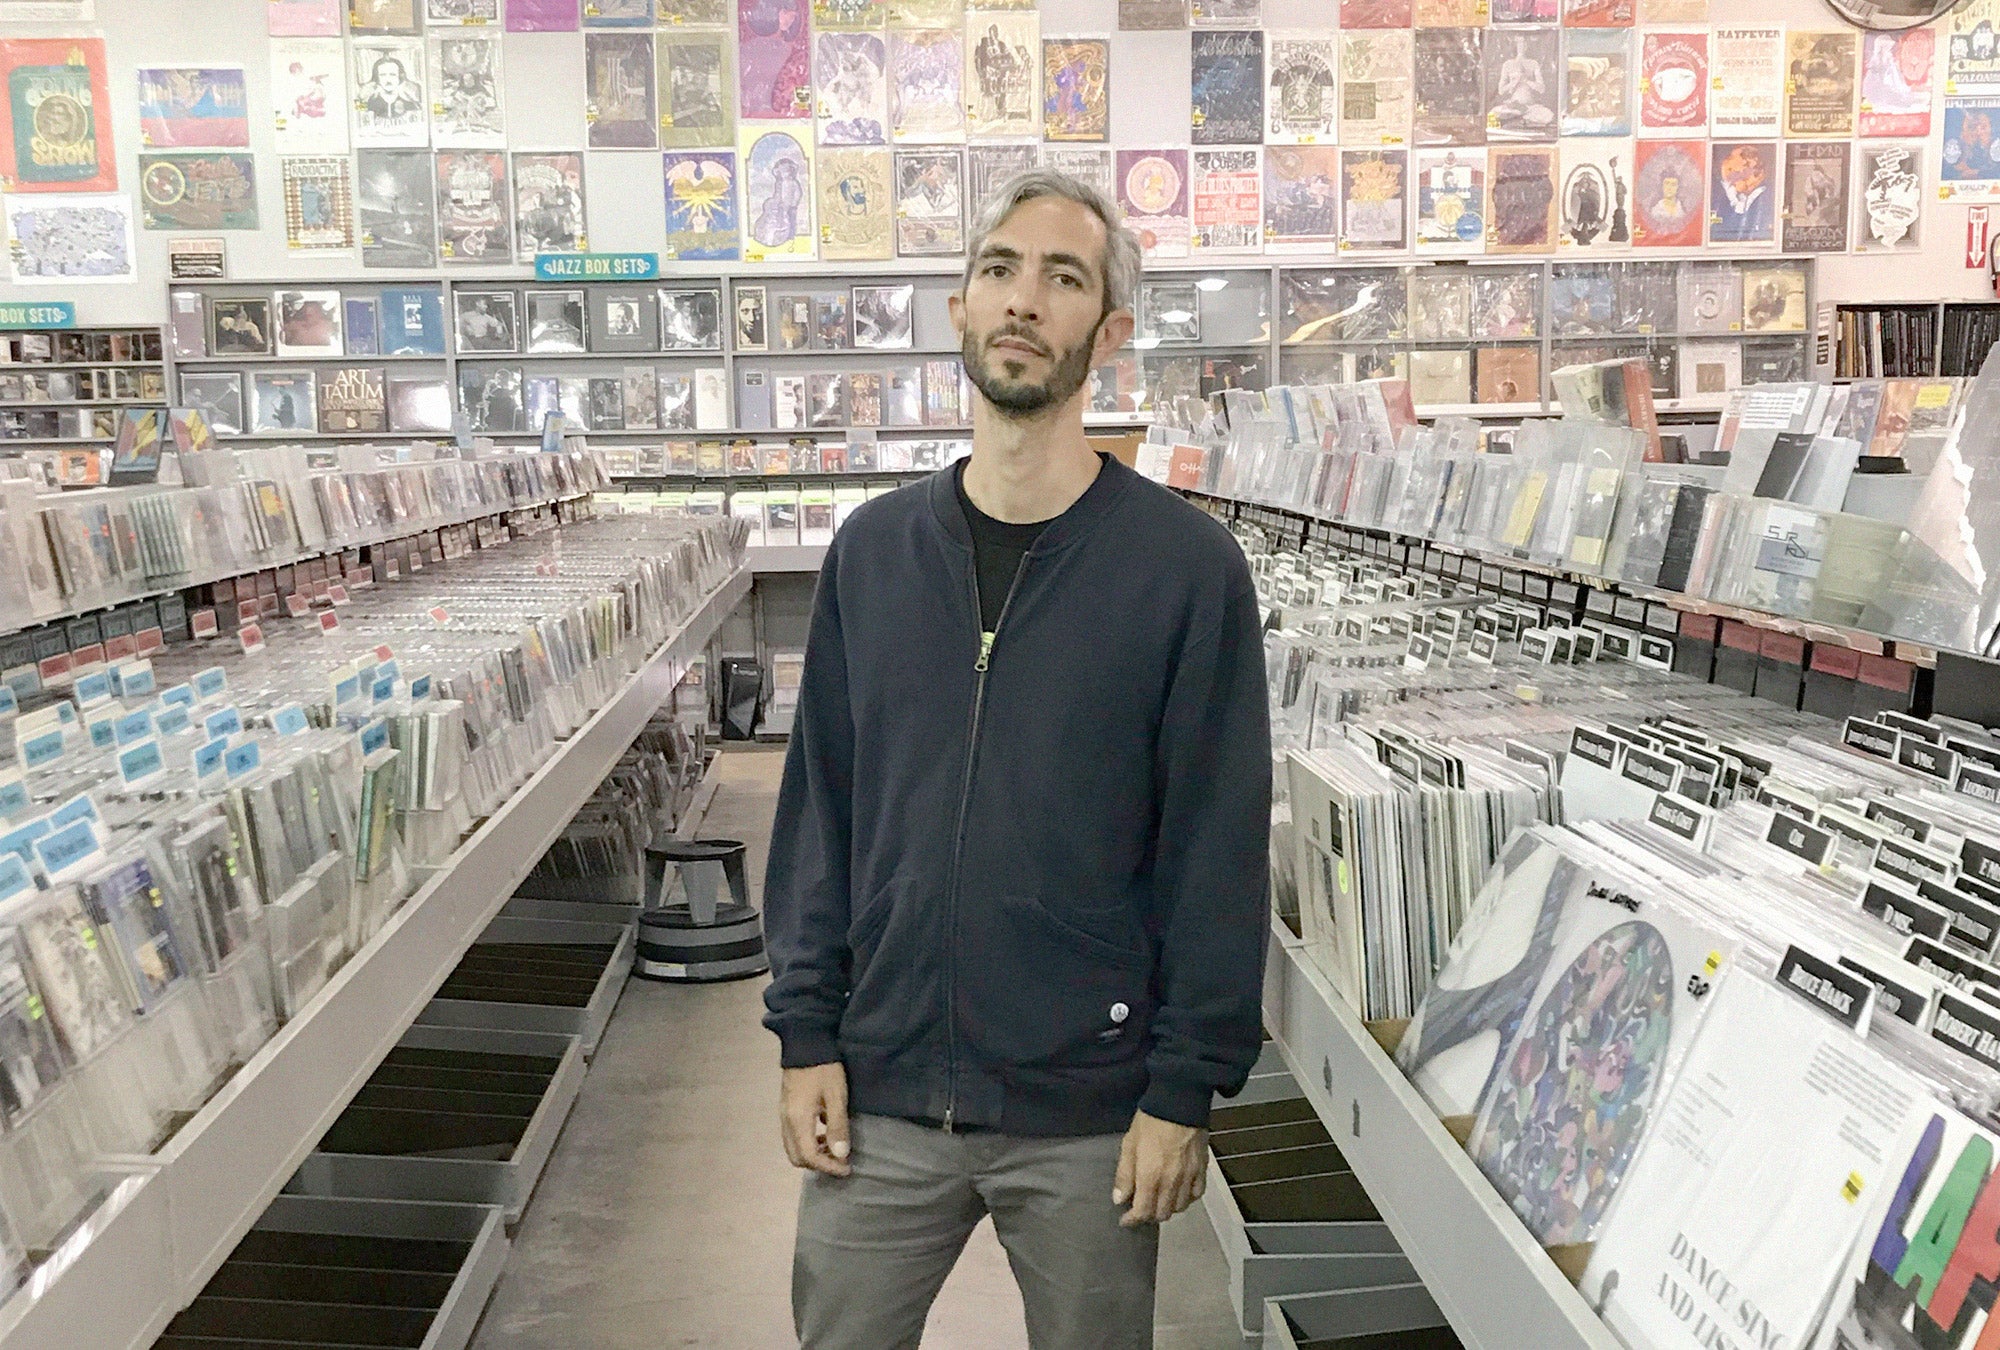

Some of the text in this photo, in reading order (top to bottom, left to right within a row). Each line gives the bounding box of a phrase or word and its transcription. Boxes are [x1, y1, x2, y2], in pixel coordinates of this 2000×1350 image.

[551, 258, 645, 275] JAZZ BOX SETS
[0, 307, 61, 323] BOX SETS
[335, 369, 370, 386] ART
[321, 384, 384, 400] TATUM
[1669, 1231, 1738, 1312] DANCE
[1657, 1272, 1739, 1350] AND LIS
